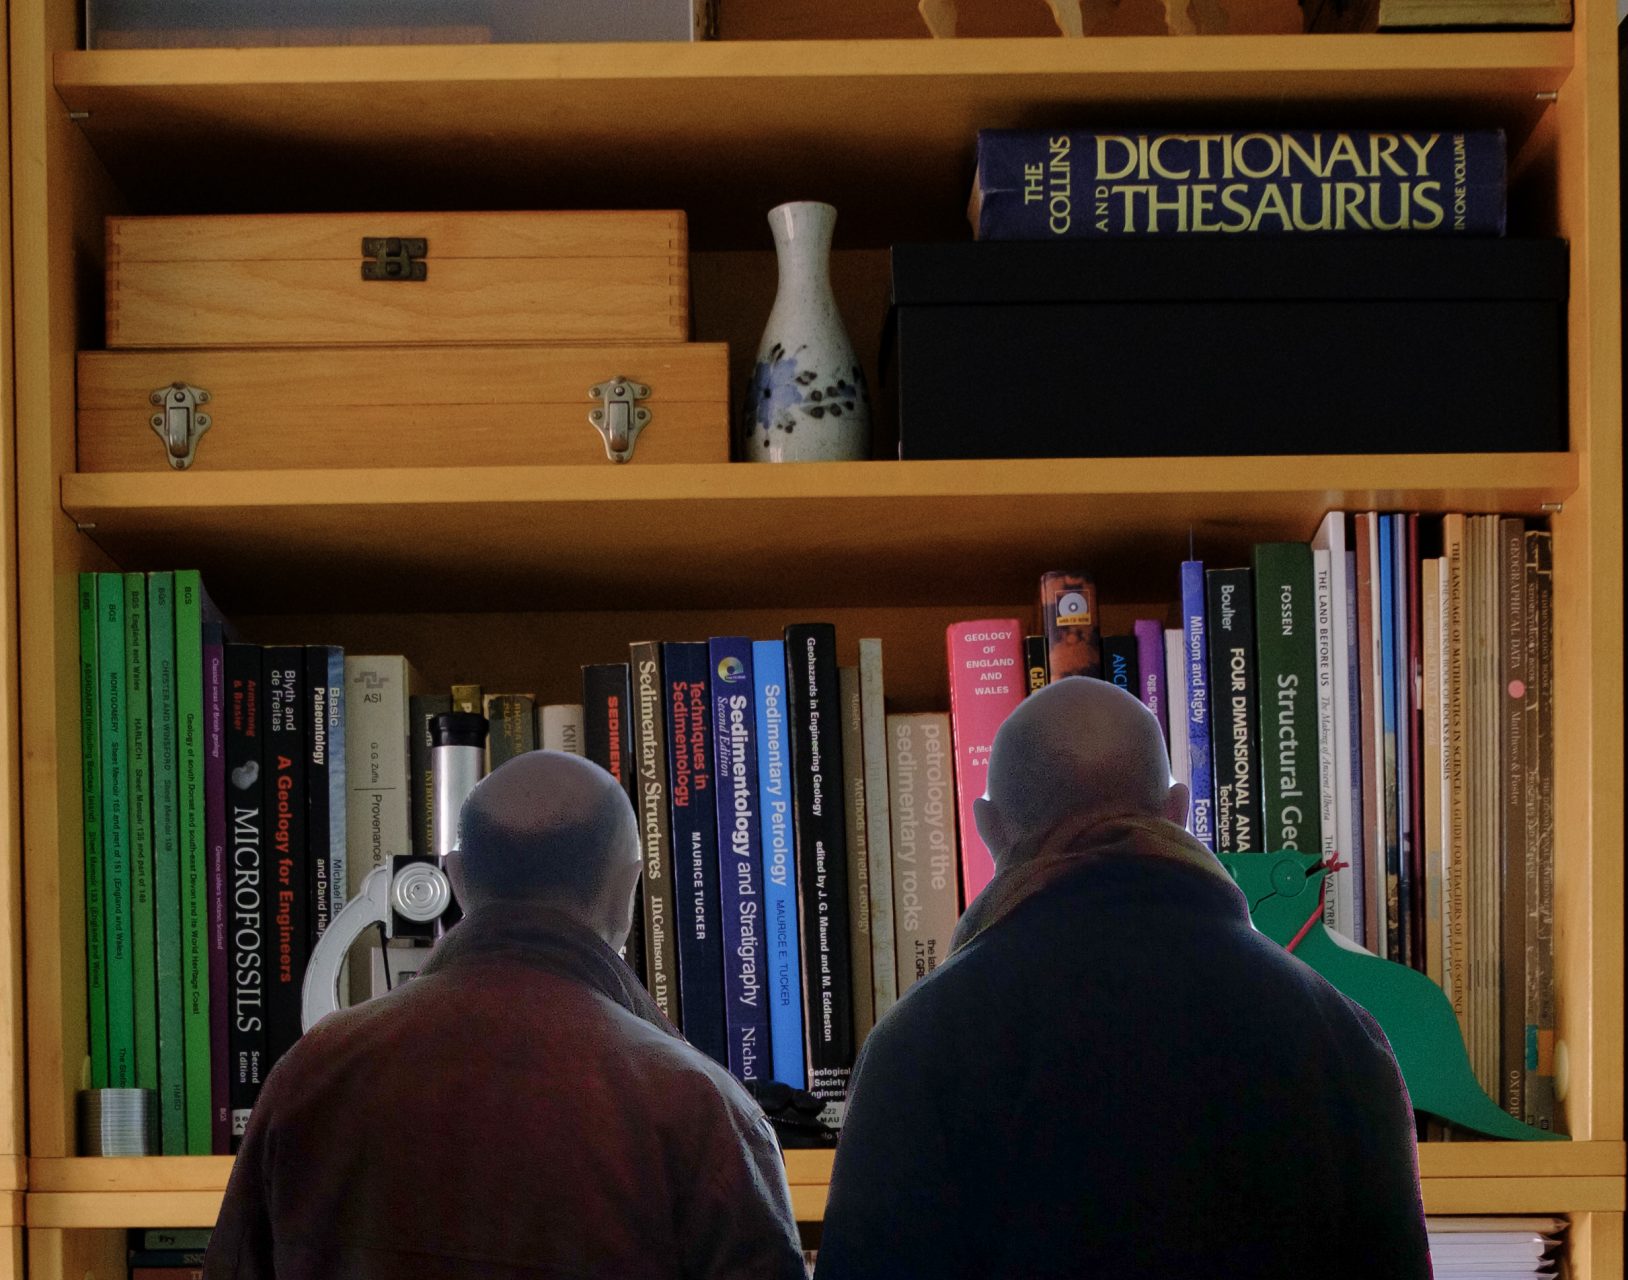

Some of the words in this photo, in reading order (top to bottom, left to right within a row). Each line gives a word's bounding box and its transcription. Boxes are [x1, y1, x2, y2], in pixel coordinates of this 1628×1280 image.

[1094, 133, 1441, 181] DICTIONARY
[1454, 134, 1466, 181] VOLUME
[1024, 162, 1043, 204] THE
[1049, 135, 1071, 234] COLLINS
[1454, 183, 1466, 212] ONE
[1095, 186, 1109, 231] AND
[1110, 181, 1445, 234] THESAURUS
[1454, 215, 1466, 230] IN
[1451, 541, 1460, 561] THE
[1318, 570, 1328, 590] THE
[1451, 566, 1461, 625] LANGUAGE
[1509, 537, 1521, 636] GEOGRAPHICAL
[1221, 585, 1235, 631] Boulter
[1281, 585, 1293, 636] FOSSEN
[1318, 595, 1328, 624] LAND
[964, 633, 1012, 642] GEOLOGY
[982, 646, 996, 654] OF
[1190, 616, 1204, 660] Milsom
[1319, 628, 1329, 668] BEFORE
[1452, 629, 1461, 644] OF
[1510, 639, 1521, 669] DATA
[270, 670, 282, 687] de
[806, 637, 818, 697] Geohazards
[966, 658, 1014, 668] ENGLAND
[980, 672, 1002, 681] AND
[1192, 664, 1204, 686] and
[1229, 648, 1246, 691] FOUR
[1320, 672, 1329, 686] US
[283, 670, 297, 703] Blyth
[328, 687, 341, 727] Basic
[809, 699, 819, 709] in
[974, 686, 1010, 695] WALES
[1191, 689, 1207, 723] Rigby
[1452, 649, 1462, 726] MATHEMATICS
[270, 690, 283, 732] Freitas
[285, 706, 297, 731] and
[312, 687, 326, 765] Palaeontology
[639, 660, 659, 779] Sedimentary
[690, 681, 708, 770] Techniques
[717, 696, 729, 733] Second
[673, 681, 693, 807] Sedimentology
[718, 736, 730, 777] Edition
[764, 684, 783, 795] Sedimentary
[809, 712, 823, 771] Engineering
[1233, 696, 1249, 807] DIMENSIONAL
[1277, 674, 1302, 797] Structural
[1453, 730, 1462, 741] IN
[277, 755, 291, 770] A
[695, 774, 708, 790] in
[728, 695, 753, 857] Sedimentology
[922, 723, 945, 830] petrology
[275, 775, 293, 853] Geology
[811, 774, 823, 817] Geology
[897, 724, 919, 864] sedimentary
[1219, 784, 1233, 847] Techniques
[371, 794, 383, 860] Provenance
[644, 782, 663, 880] Structures
[769, 801, 787, 885] Petrology
[928, 832, 947, 850] of
[279, 859, 293, 885] for
[692, 832, 703, 888] MAURICE
[738, 862, 755, 894] and
[932, 853, 950, 890] the
[233, 807, 261, 1033] MICROFOSSILS
[694, 890, 705, 940] TUCKER
[775, 899, 788, 947] MAURICE
[902, 871, 922, 932] rocks
[276, 890, 294, 983] Engineers
[737, 901, 760, 1006] Stratigraphy
[778, 964, 790, 1006] TUCKER
[239, 1050, 249, 1084] Edition
[250, 1050, 261, 1084] Second
